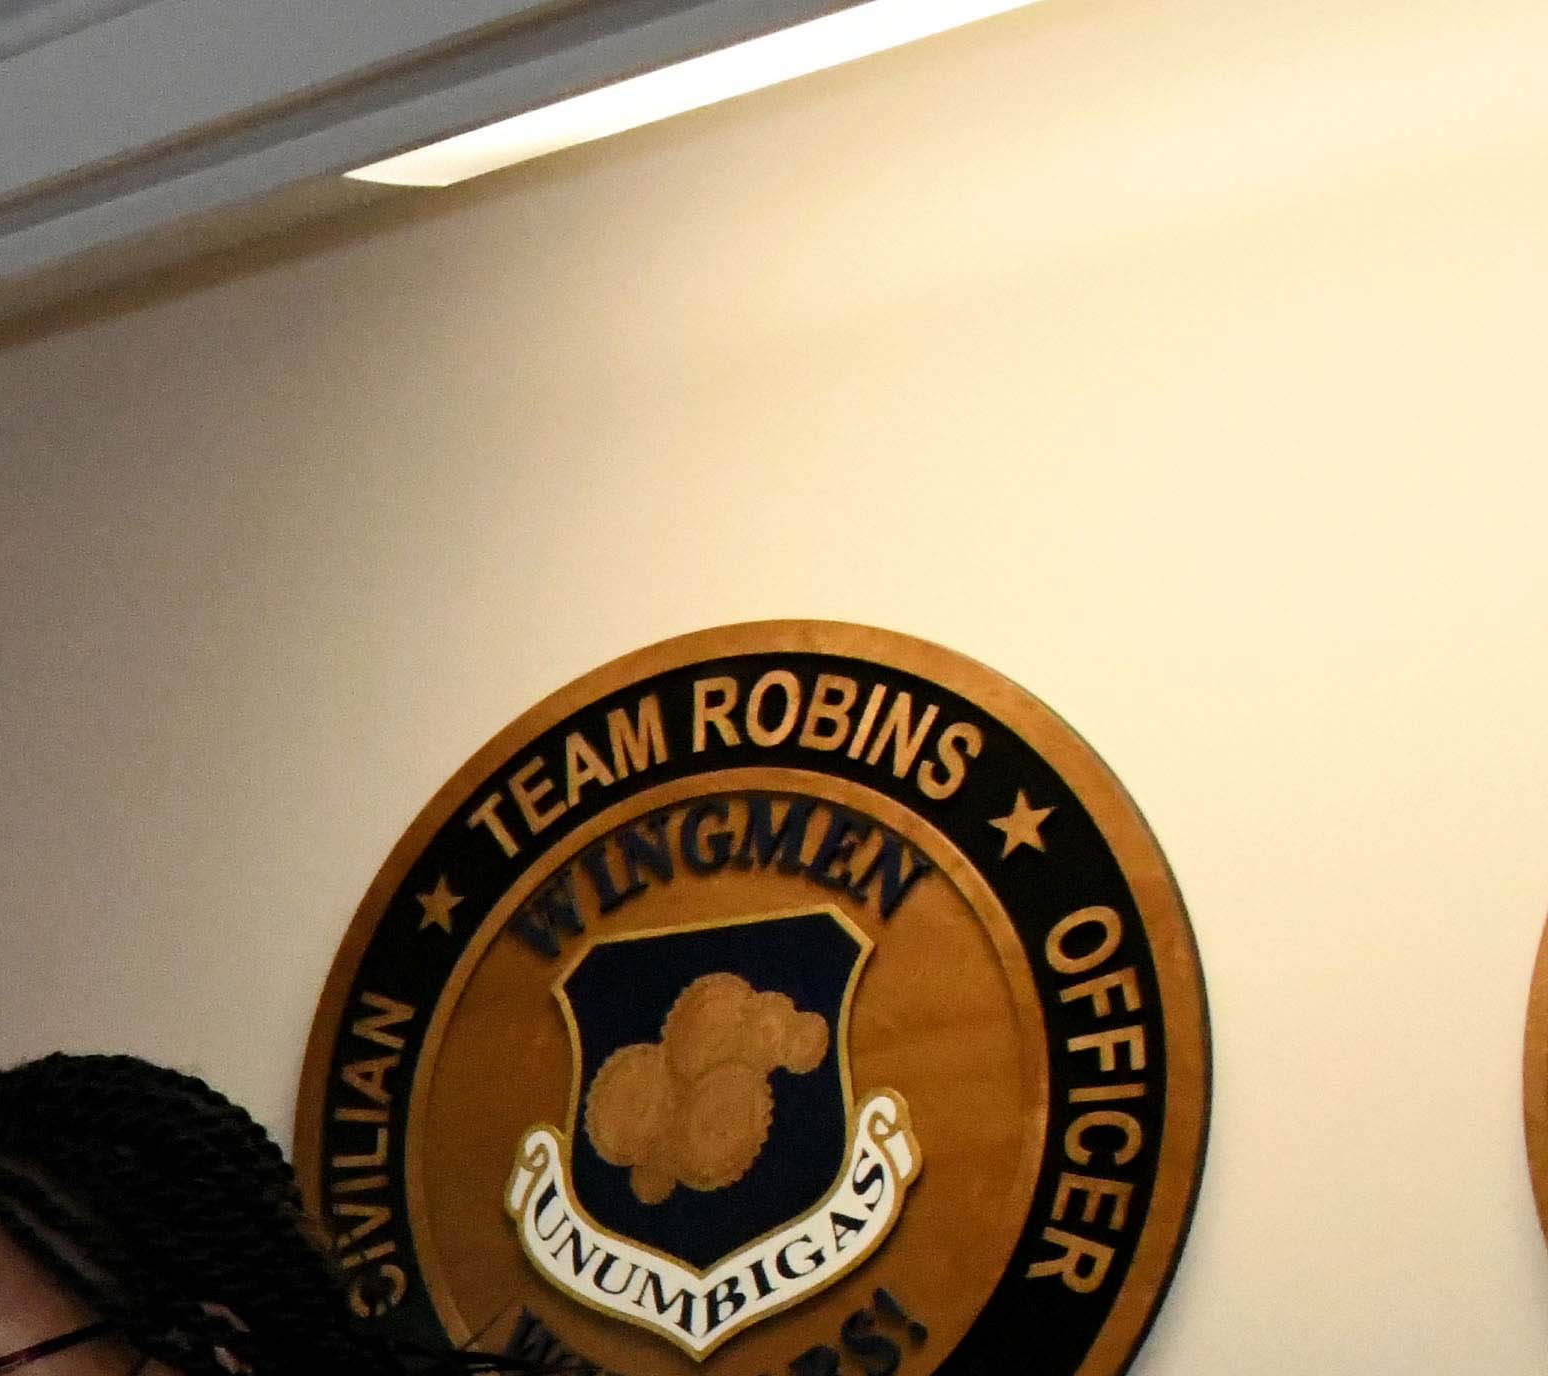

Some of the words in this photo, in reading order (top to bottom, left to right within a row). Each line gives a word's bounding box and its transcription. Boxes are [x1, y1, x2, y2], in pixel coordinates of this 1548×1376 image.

[466, 694, 669, 859] TEAM
[691, 668, 984, 800] ROBINS
[508, 797, 936, 962] WINGMEN
[330, 992, 416, 1320] CIVILIAN
[1026, 904, 1148, 1297] OFFICER
